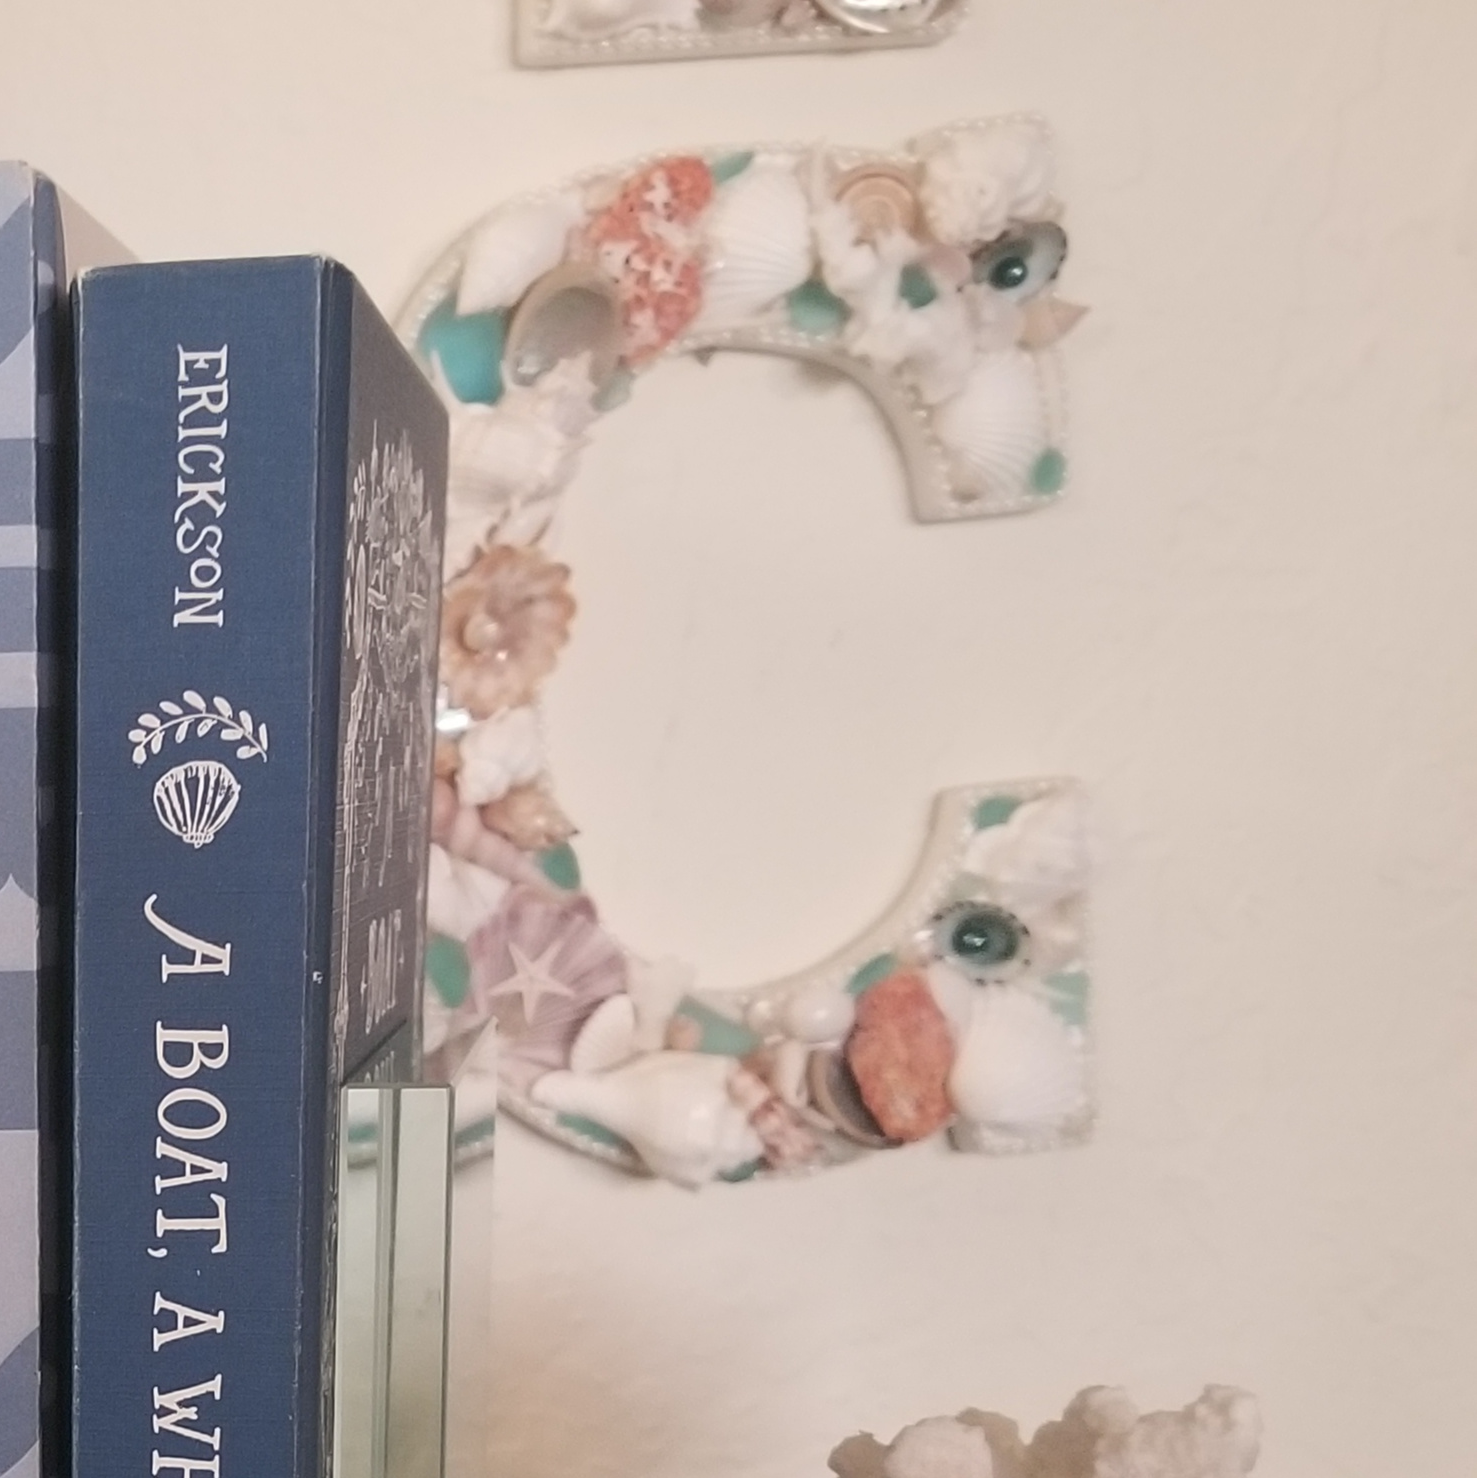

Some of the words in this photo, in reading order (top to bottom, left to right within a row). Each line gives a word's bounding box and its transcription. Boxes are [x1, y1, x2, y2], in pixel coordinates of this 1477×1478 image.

[173, 343, 228, 629] ERICKSON
[143, 893, 232, 984] A
[147, 1019, 230, 1260] BOAT,
[152, 1291, 225, 1352] A
